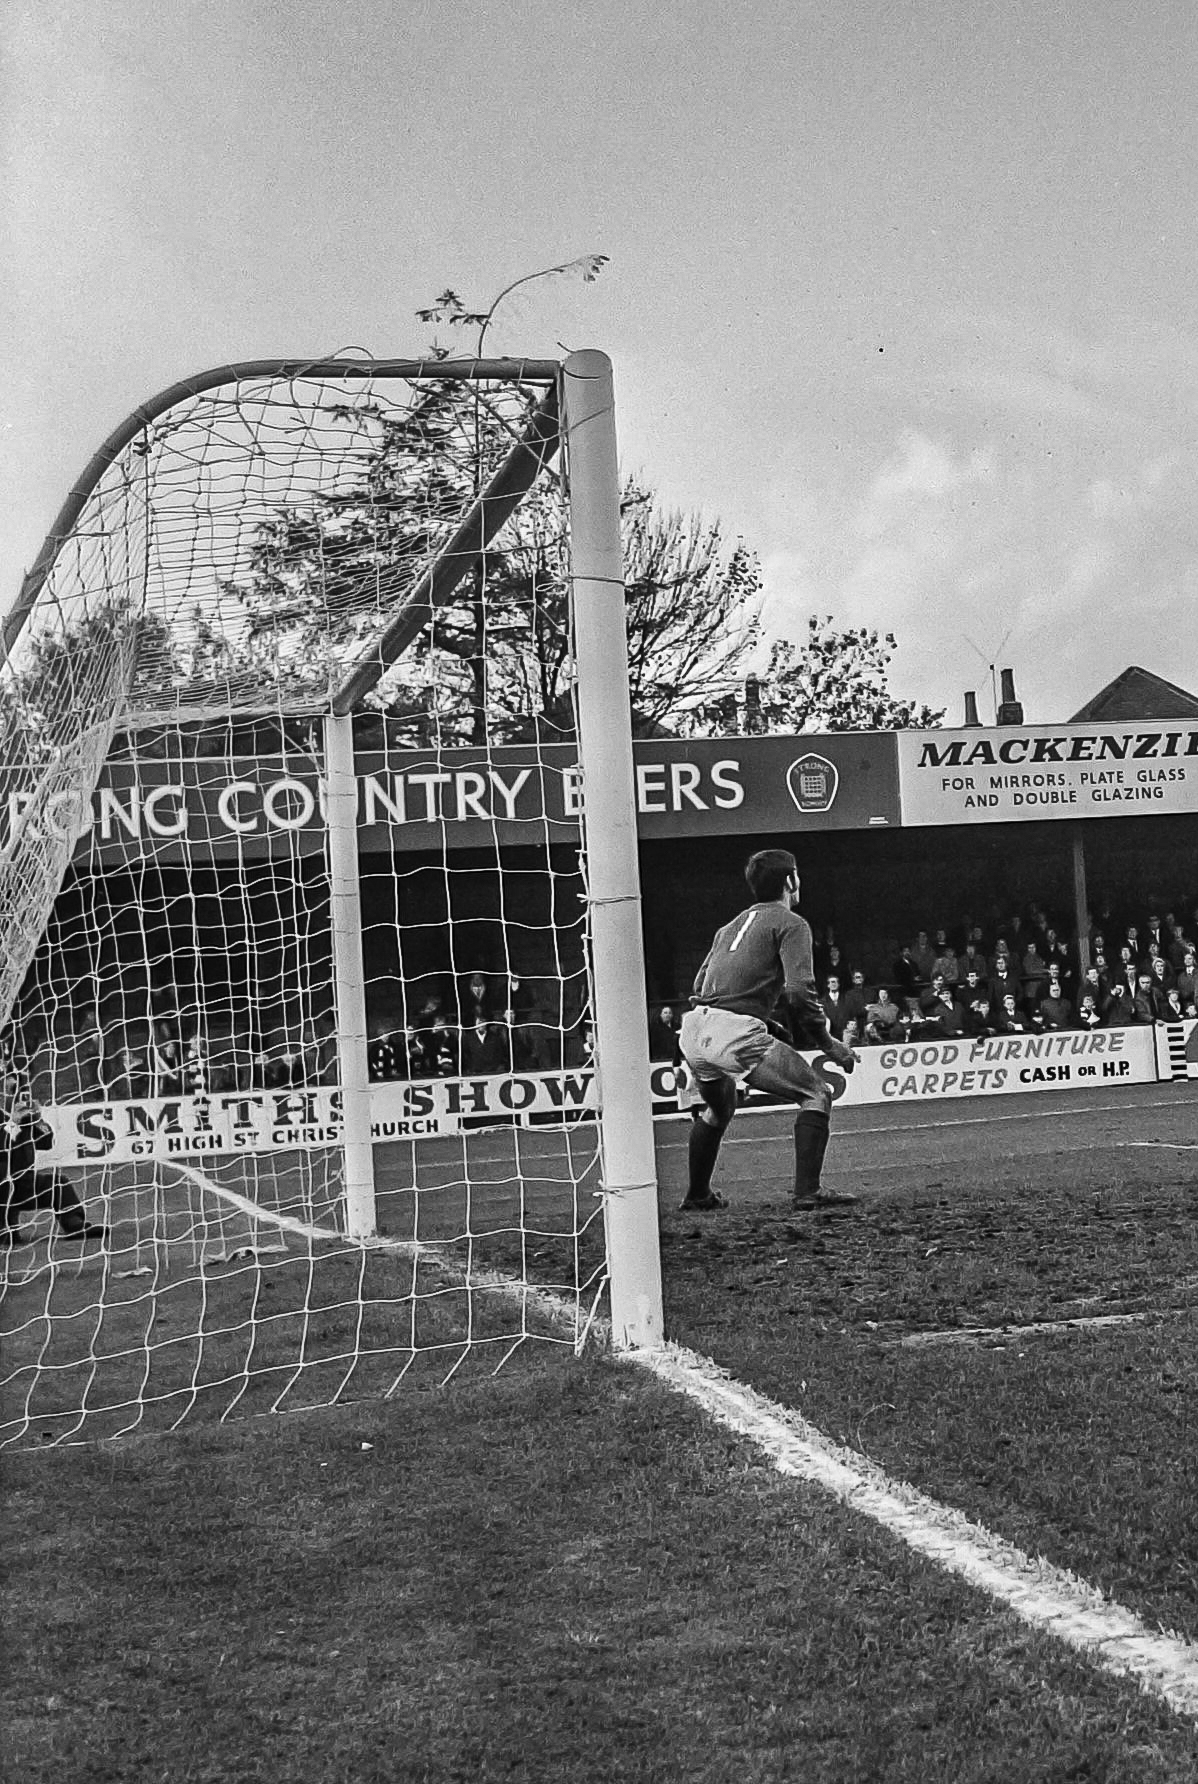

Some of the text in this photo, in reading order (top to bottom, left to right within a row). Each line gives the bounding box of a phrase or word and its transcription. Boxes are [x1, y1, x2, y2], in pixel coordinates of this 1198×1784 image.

[562, 760, 745, 816] BERS
[942, 777, 976, 791] FOR
[1080, 770, 1124, 786] PLATE
[1136, 768, 1186, 783] GLASS
[964, 786, 1164, 808] AND DOUBLE GLAZING
[729, 911, 758, 951] 1
[880, 1032, 1126, 1069] GOOD FURNITURE
[881, 1061, 1130, 1097] CARPETS CASH OR H.P.
[168, 1133, 223, 1152] HIGH
[234, 1131, 260, 1146] ST
[272, 1119, 439, 1143] CHRISHURCH
